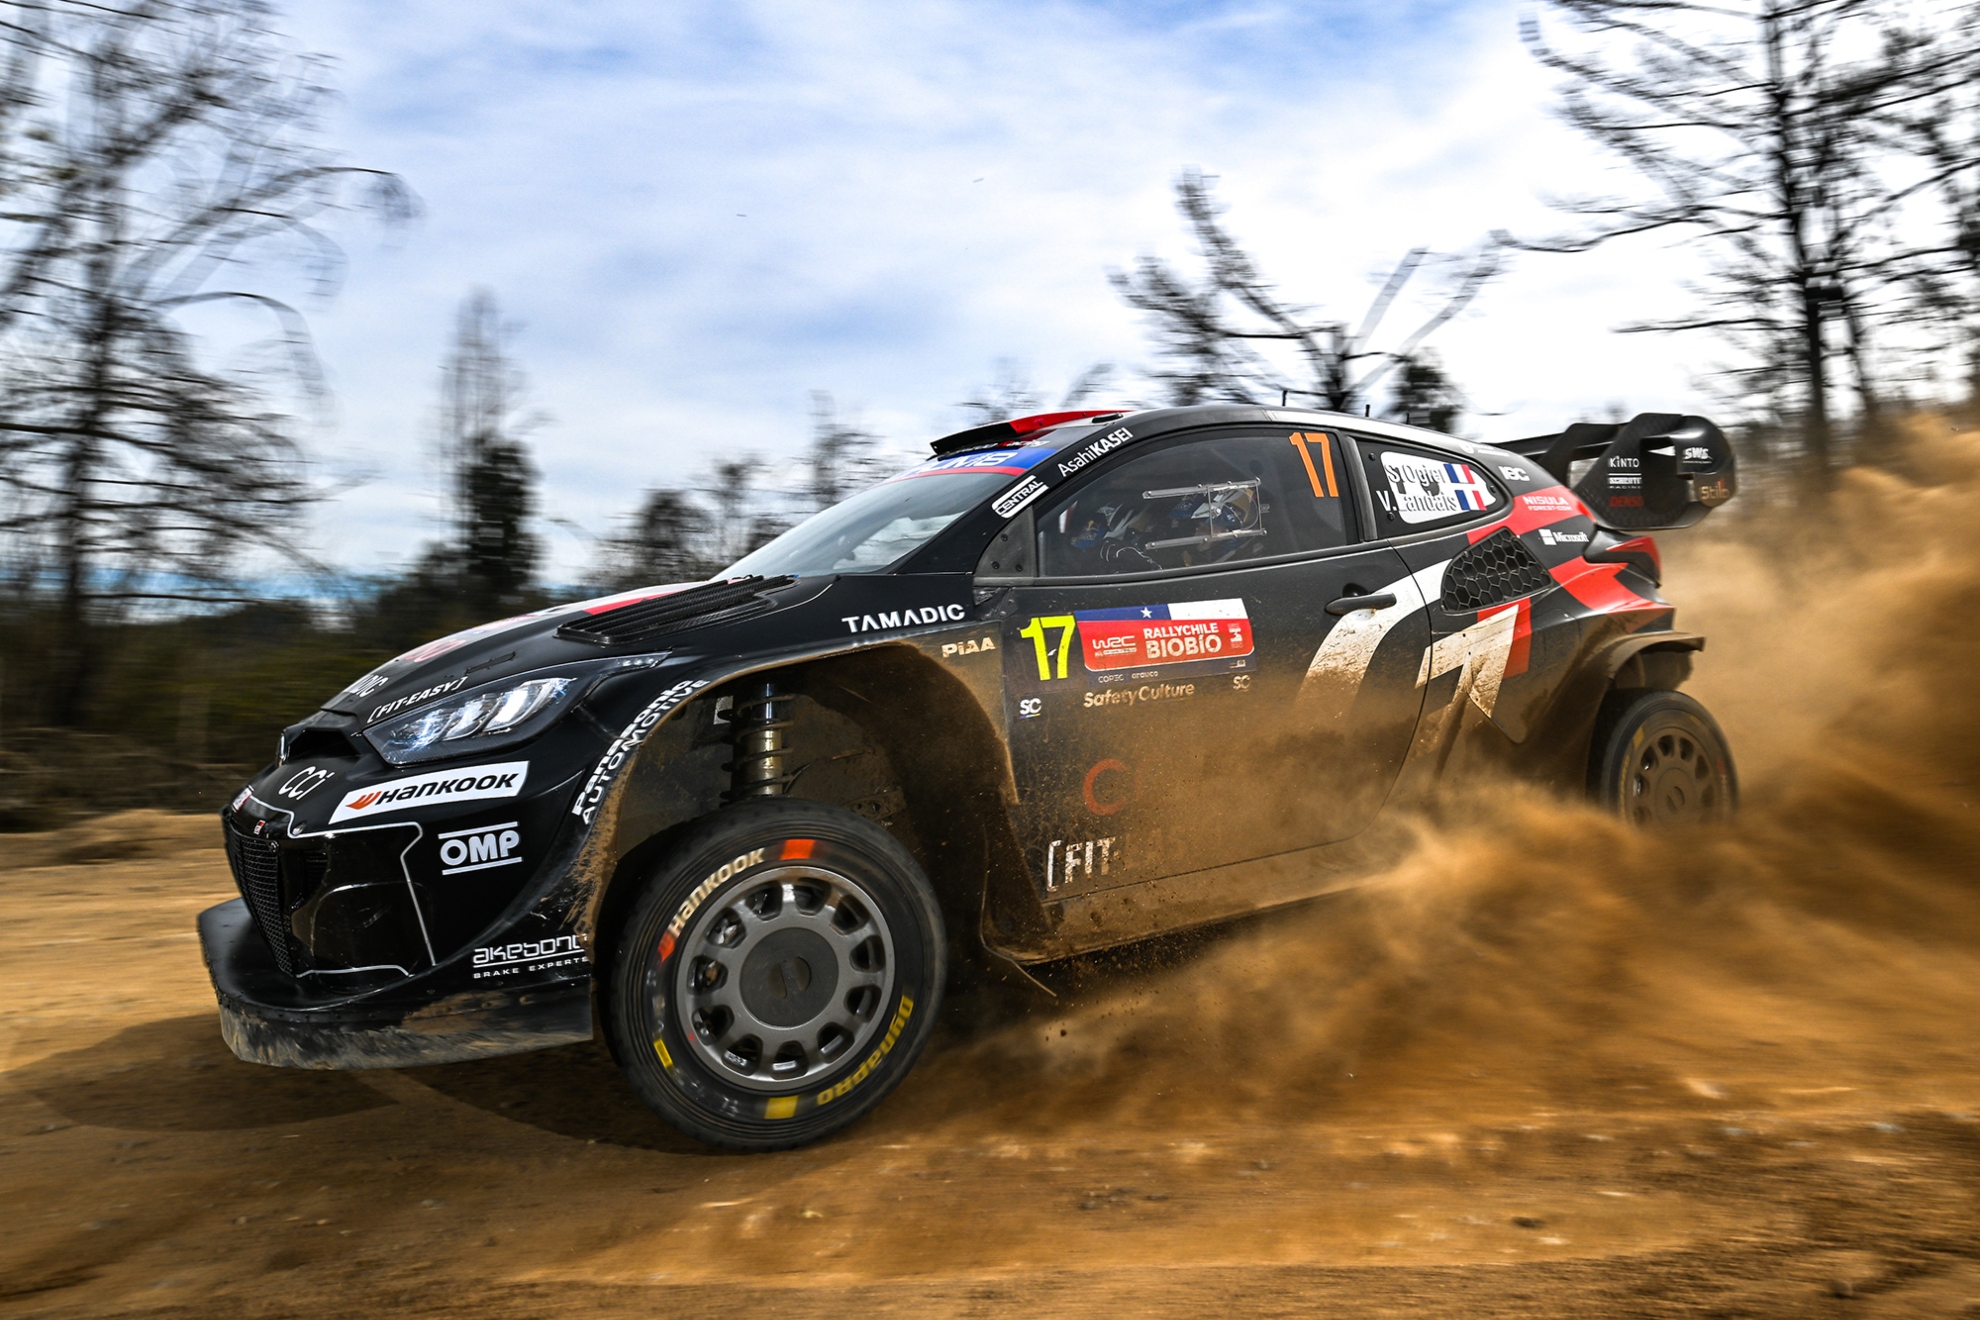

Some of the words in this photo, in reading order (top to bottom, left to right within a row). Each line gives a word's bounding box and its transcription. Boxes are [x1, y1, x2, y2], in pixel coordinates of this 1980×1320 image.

[1056, 427, 1134, 477] AsahiKASEI
[1289, 431, 1339, 498] 17
[995, 479, 1044, 516] CENTRAL
[1376, 490, 1398, 512] V.
[1522, 496, 1569, 506] NISULA
[1552, 531, 1590, 542] Microsoft
[841, 604, 966, 633] TAMADIC
[1019, 615, 1077, 681] 17
[1092, 635, 1136, 649] WRC
[1019, 697, 1042, 715] SC
[572, 680, 693, 816] Panasonic
[582, 680, 710, 825] AUTOMOTIVE
[440, 830, 520, 866] OMP
[473, 967, 520, 979] BRAKE
[529, 956, 589, 972] EXPERTS
